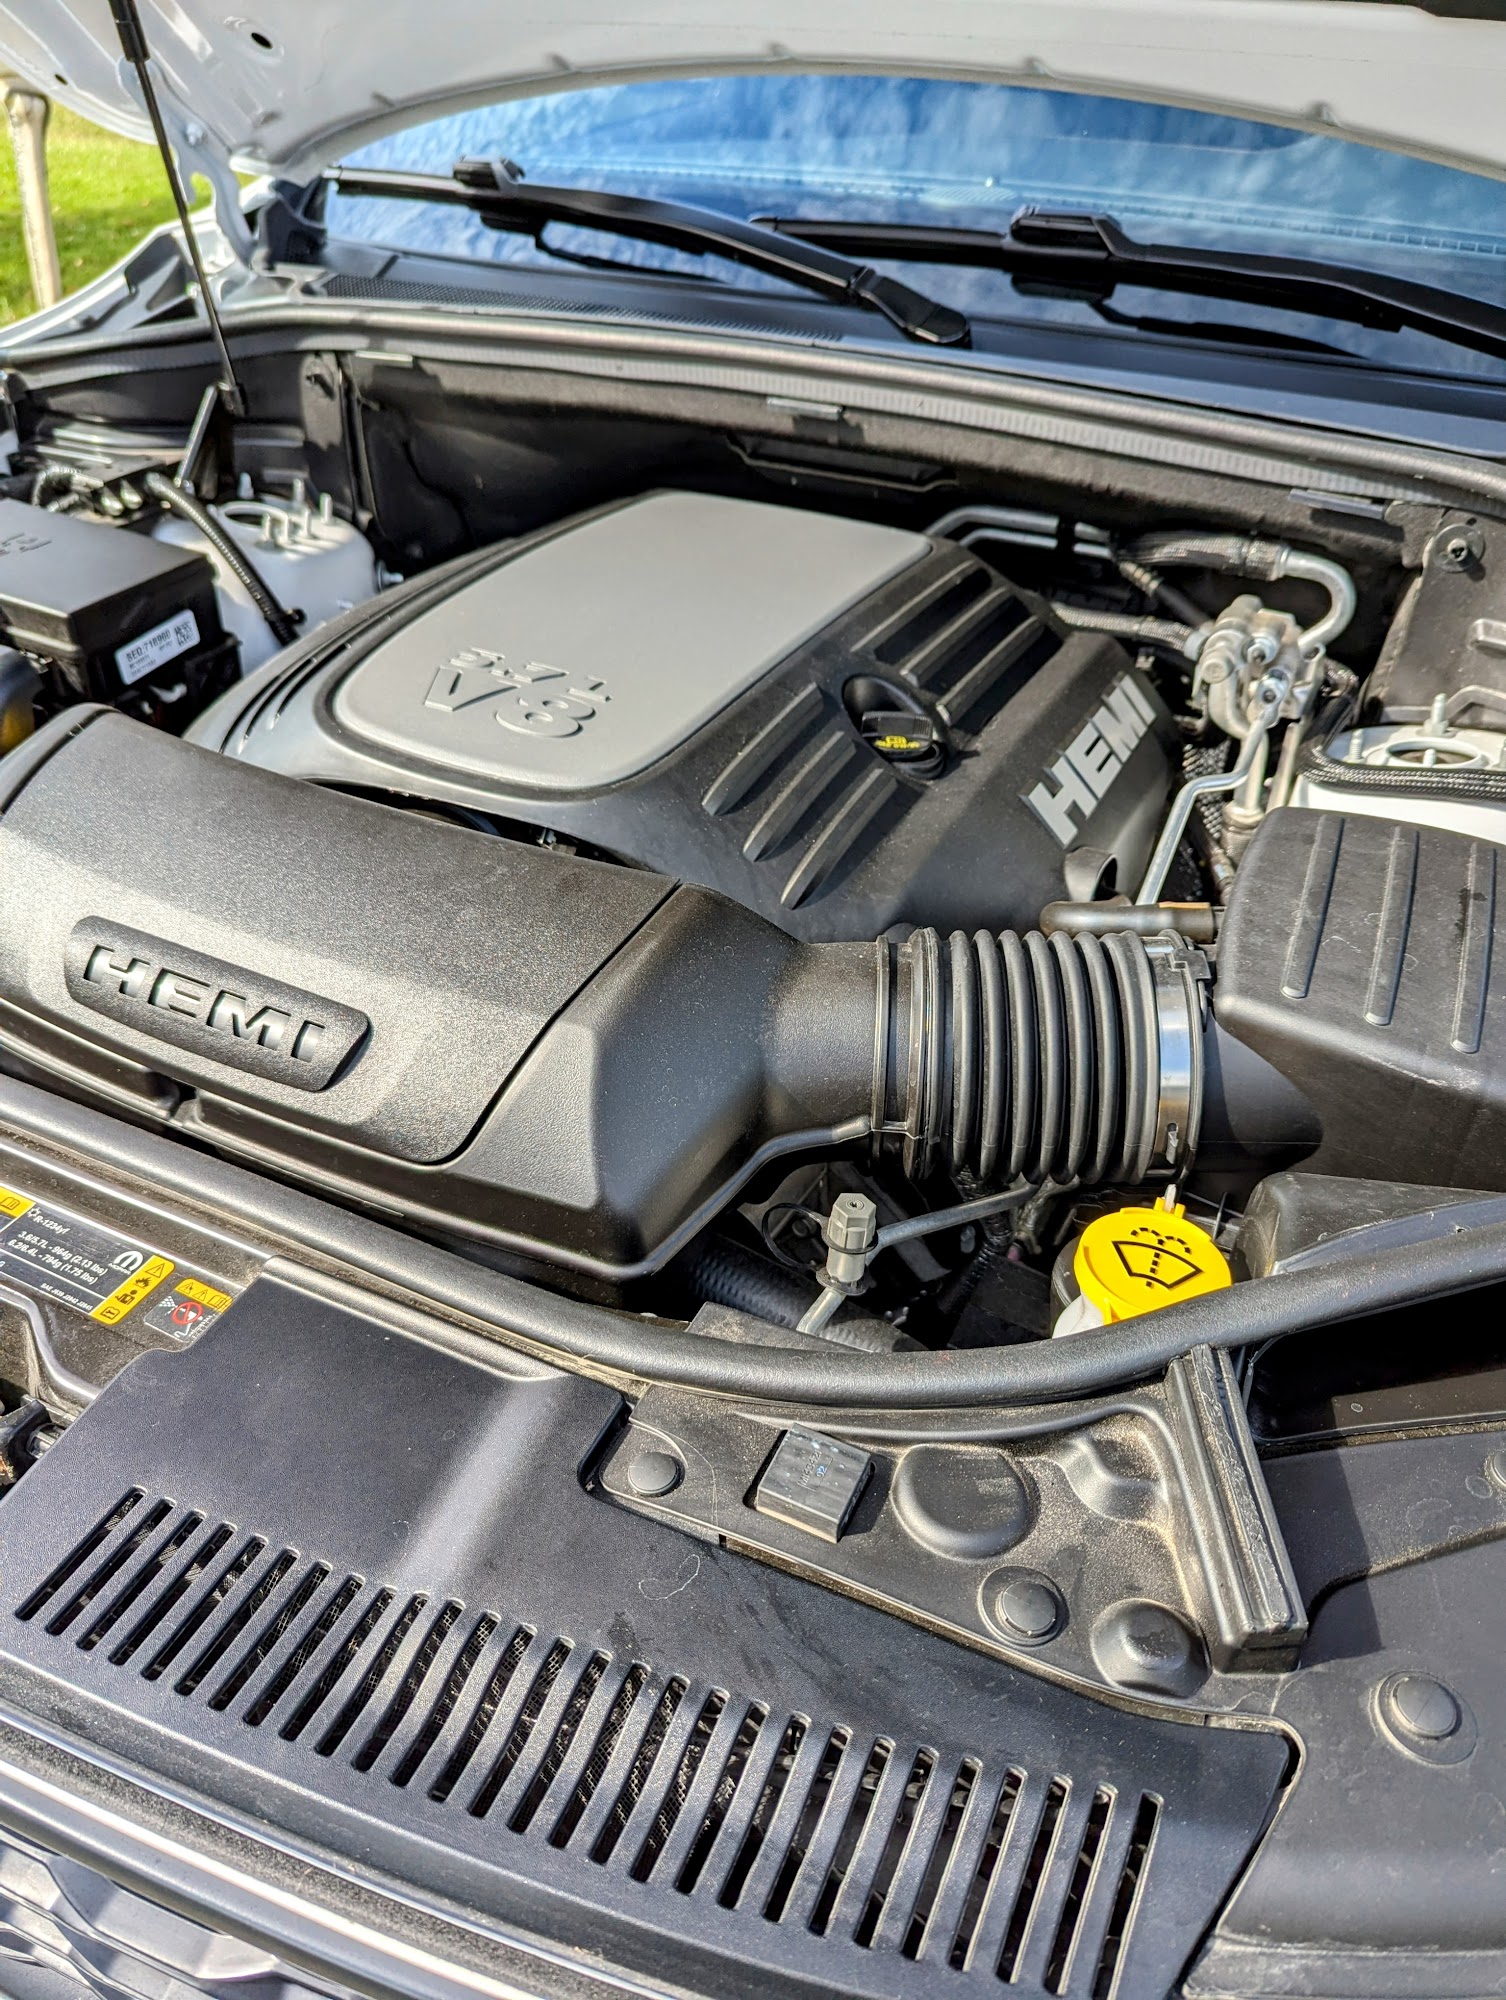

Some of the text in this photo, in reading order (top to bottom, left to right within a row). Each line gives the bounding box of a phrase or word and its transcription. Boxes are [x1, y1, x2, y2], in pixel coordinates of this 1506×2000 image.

[424, 664, 597, 738] V8
[1020, 672, 1157, 849] HEMI
[83, 944, 326, 1063] HEMI
[18, 1230, 49, 1249] 3.6/5.7L
[51, 1245, 73, 1260] 964g
[71, 1254, 93, 1268] (2.13
[90, 1263, 108, 1276] lbs)
[33, 1215, 71, 1235] R-1234yf
[7, 1239, 39, 1257] 6.2/6.4L
[41, 1254, 63, 1269] 794g
[60, 1263, 83, 1276] (1.75
[80, 1272, 98, 1285] lbs)
